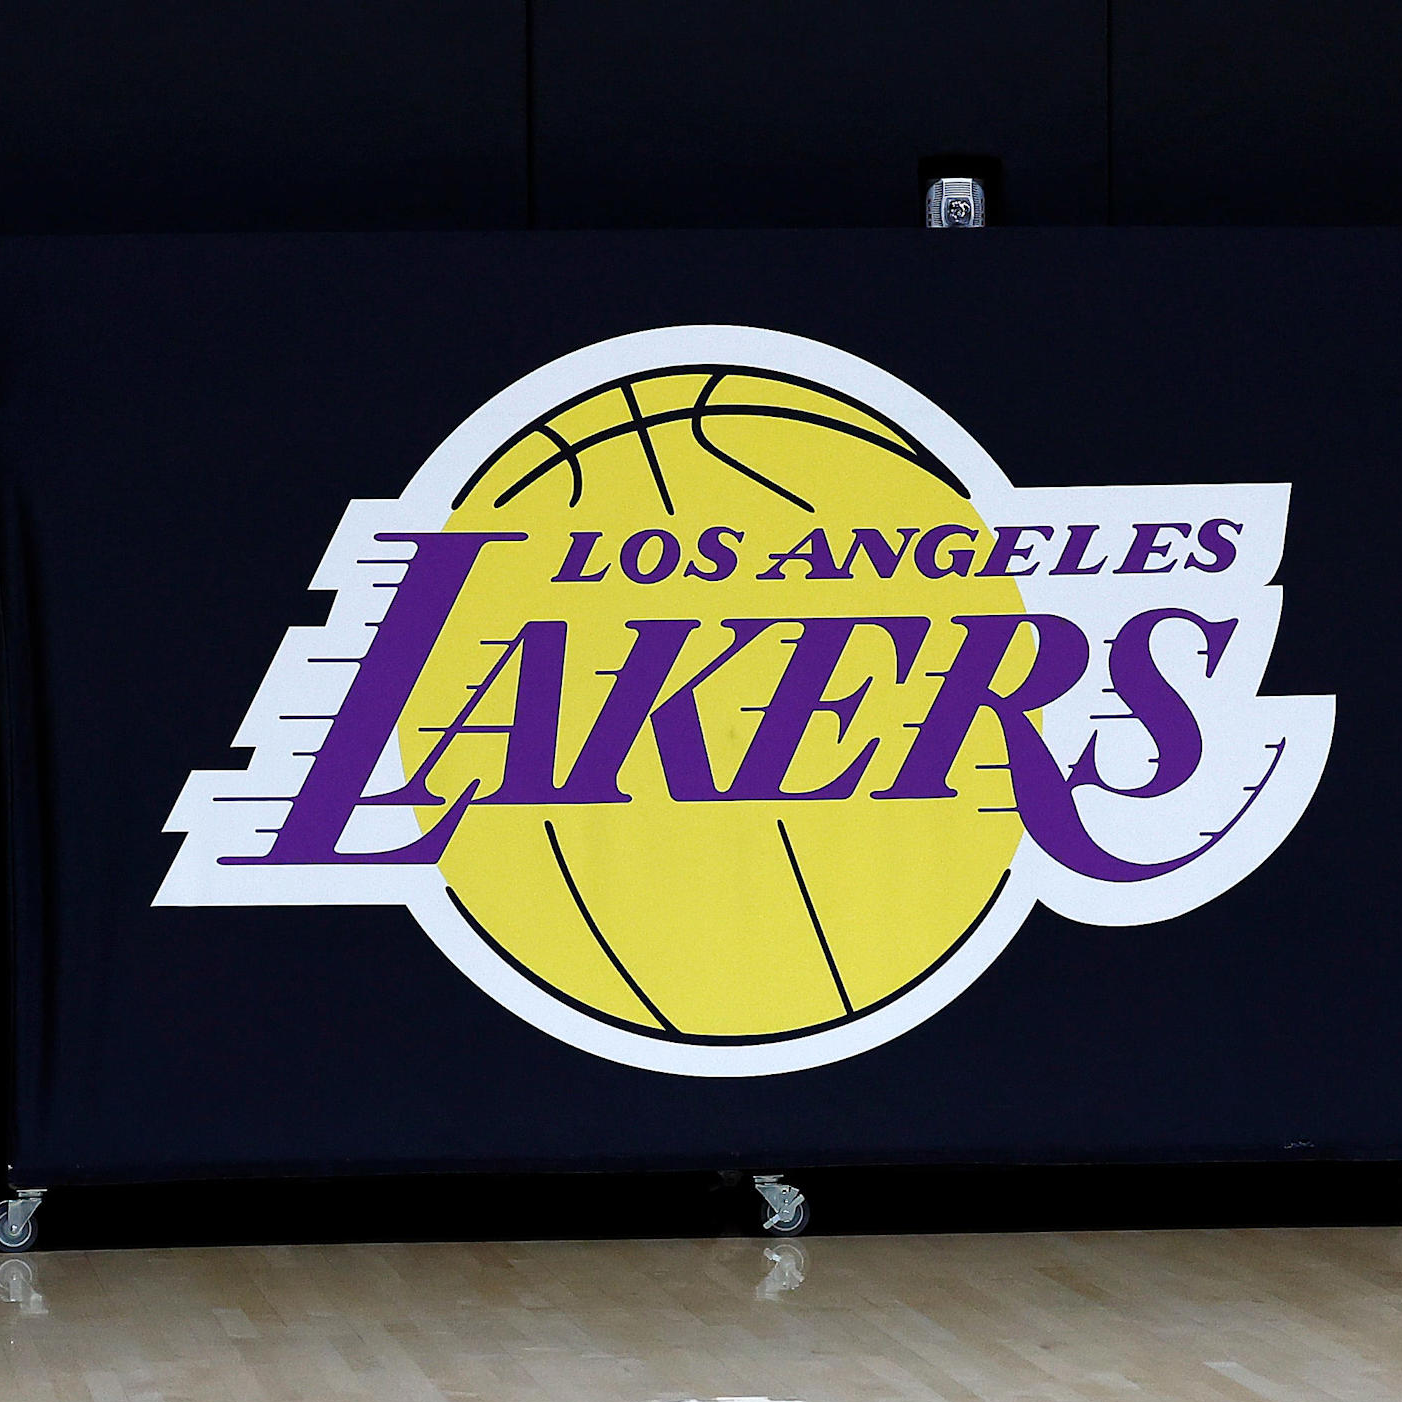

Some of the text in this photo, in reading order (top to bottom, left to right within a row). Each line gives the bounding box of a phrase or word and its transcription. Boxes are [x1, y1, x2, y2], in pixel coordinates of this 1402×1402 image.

[552, 520, 1243, 584] LOS ANGELES
[215, 532, 1286, 883] LAKERS
